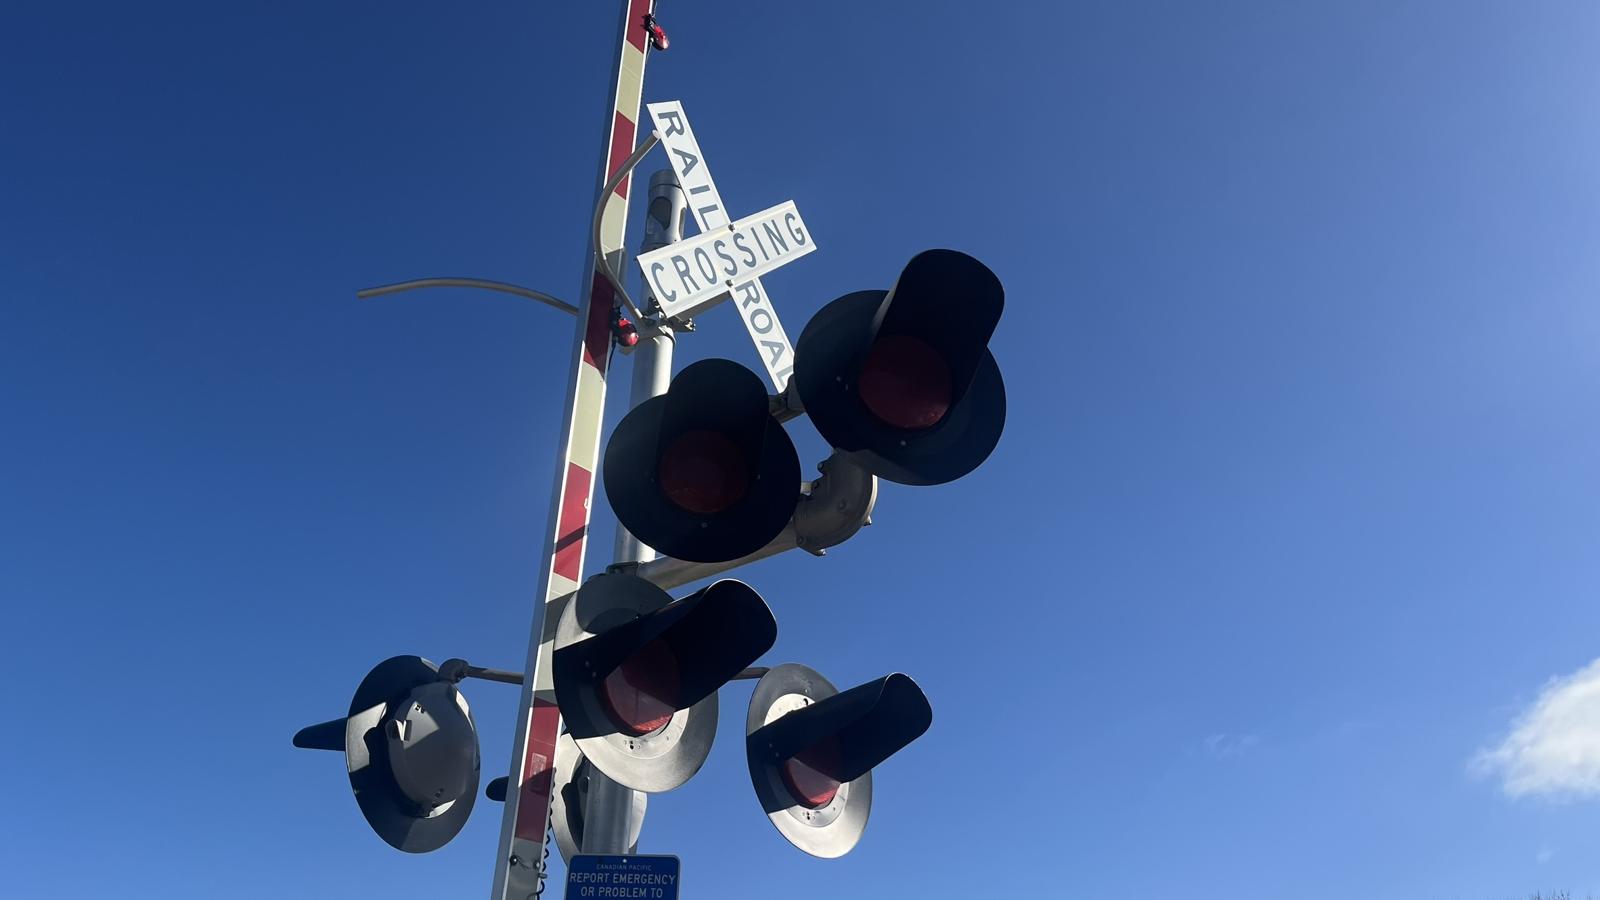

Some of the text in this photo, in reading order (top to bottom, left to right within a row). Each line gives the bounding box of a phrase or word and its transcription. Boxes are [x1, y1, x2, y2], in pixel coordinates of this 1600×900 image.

[657, 110, 719, 231] RAIL
[651, 212, 806, 303] CROSSING
[570, 872, 676, 885] REPORT EMERGENCY
[580, 886, 663, 898] OR PROBLEM TO
